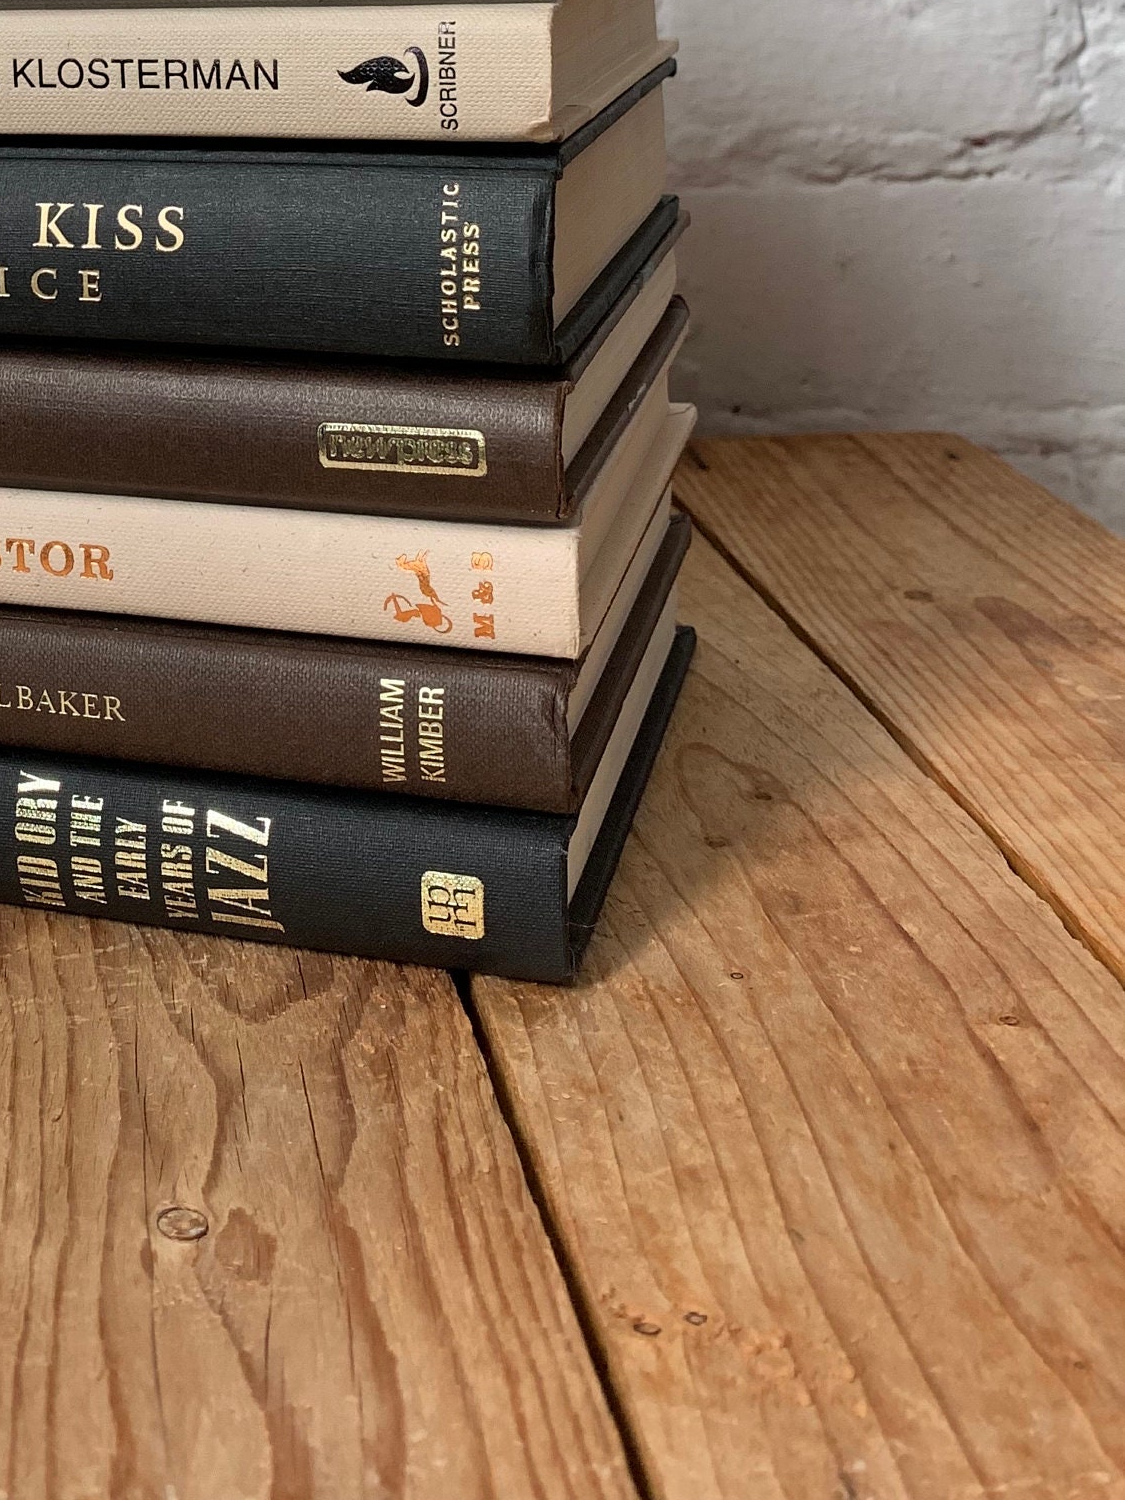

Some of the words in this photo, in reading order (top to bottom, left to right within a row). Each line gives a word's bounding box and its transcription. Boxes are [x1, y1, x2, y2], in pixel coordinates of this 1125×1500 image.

[12, 57, 279, 91] KLOSTERMAN
[438, 20, 459, 132] SCRIBNER
[33, 202, 186, 252] KISS
[440, 182, 461, 347] SCHOLASTIC
[463, 221, 481, 311] PRESS
[473, 612, 496, 640] M
[380, 678, 407, 784] WILLIAM
[418, 686, 446, 783] KIMBER
[14, 770, 61, 845] ORY
[69, 794, 104, 848] THE
[161, 799, 196, 835] OF
[17, 855, 67, 907] KID
[70, 856, 108, 905] AND
[114, 816, 151, 901] EARLY
[161, 844, 200, 919] YEARS
[205, 809, 286, 934] JAZZ
